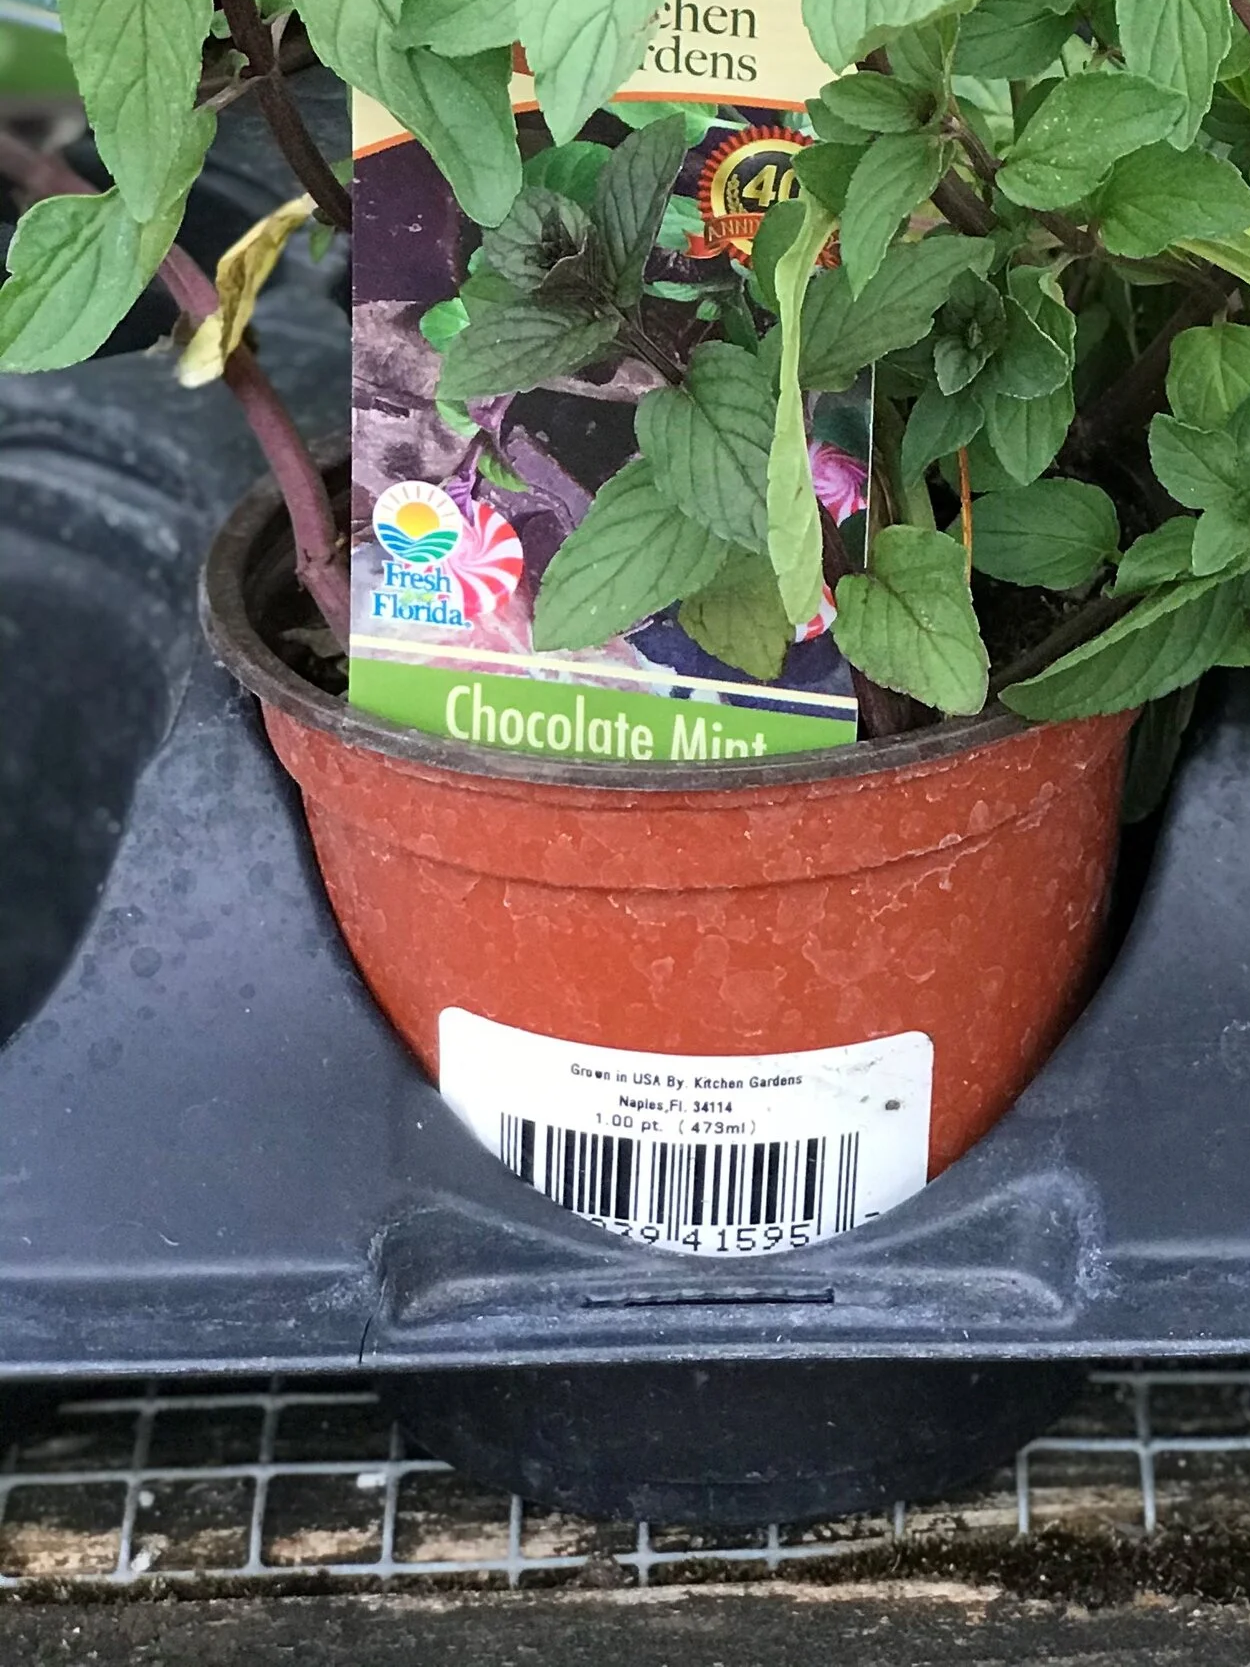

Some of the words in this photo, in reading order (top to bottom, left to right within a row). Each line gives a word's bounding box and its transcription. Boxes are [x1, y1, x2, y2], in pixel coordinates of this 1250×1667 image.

[384, 561, 452, 593] Fresh
[445, 681, 654, 760] Chocolate
[616, 1070, 628, 1083] in
[632, 1072, 662, 1087] USA
[694, 1075, 744, 1089] Kitchen
[749, 1074, 803, 1089] Gardens
[693, 1100, 733, 1113] 34114
[595, 1112, 634, 1129] 1.00
